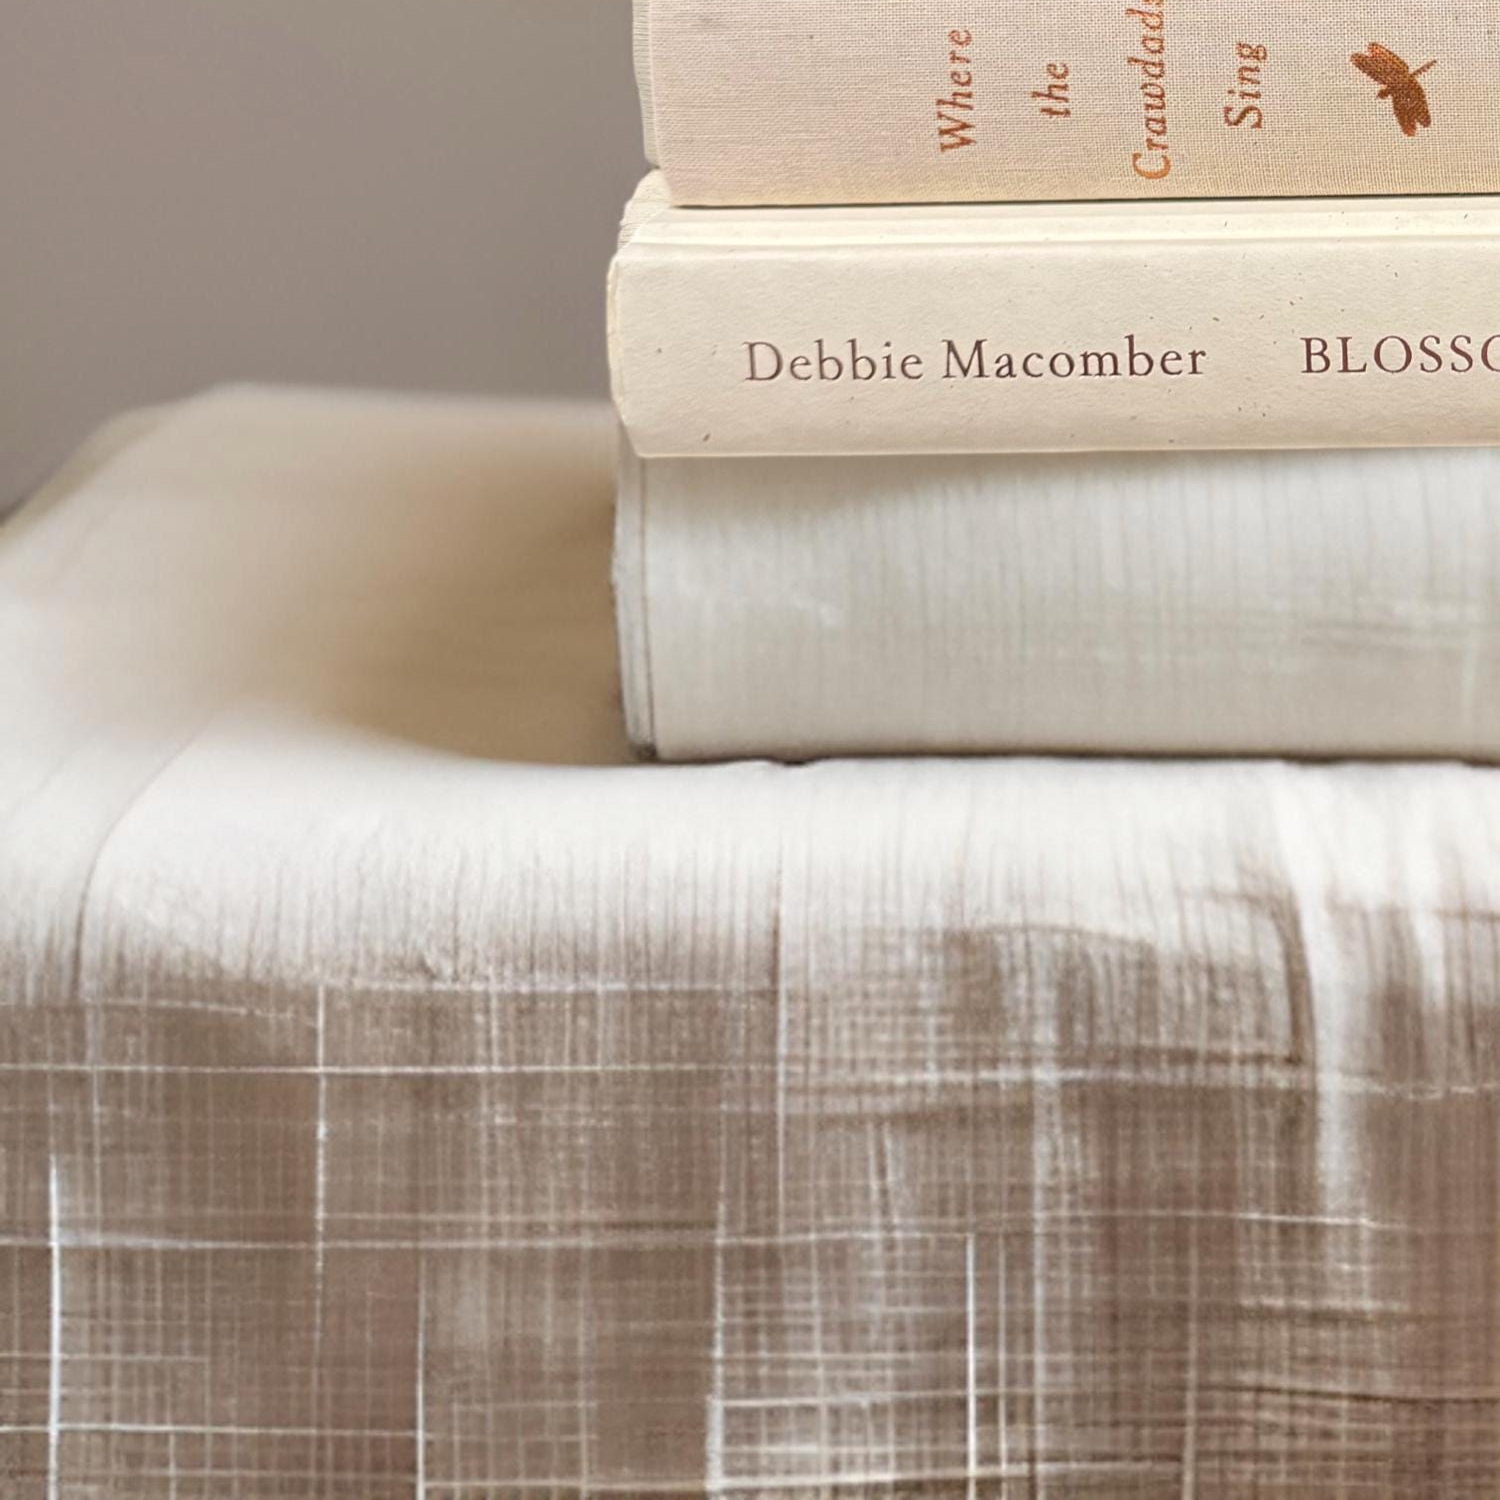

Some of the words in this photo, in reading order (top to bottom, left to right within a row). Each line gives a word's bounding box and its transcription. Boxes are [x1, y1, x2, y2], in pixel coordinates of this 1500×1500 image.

[935, 29, 977, 153] Where
[1030, 63, 1072, 119] the
[1223, 41, 1268, 130] Sing
[744, 338, 923, 382] Debbie
[943, 333, 1207, 379] Macomber
